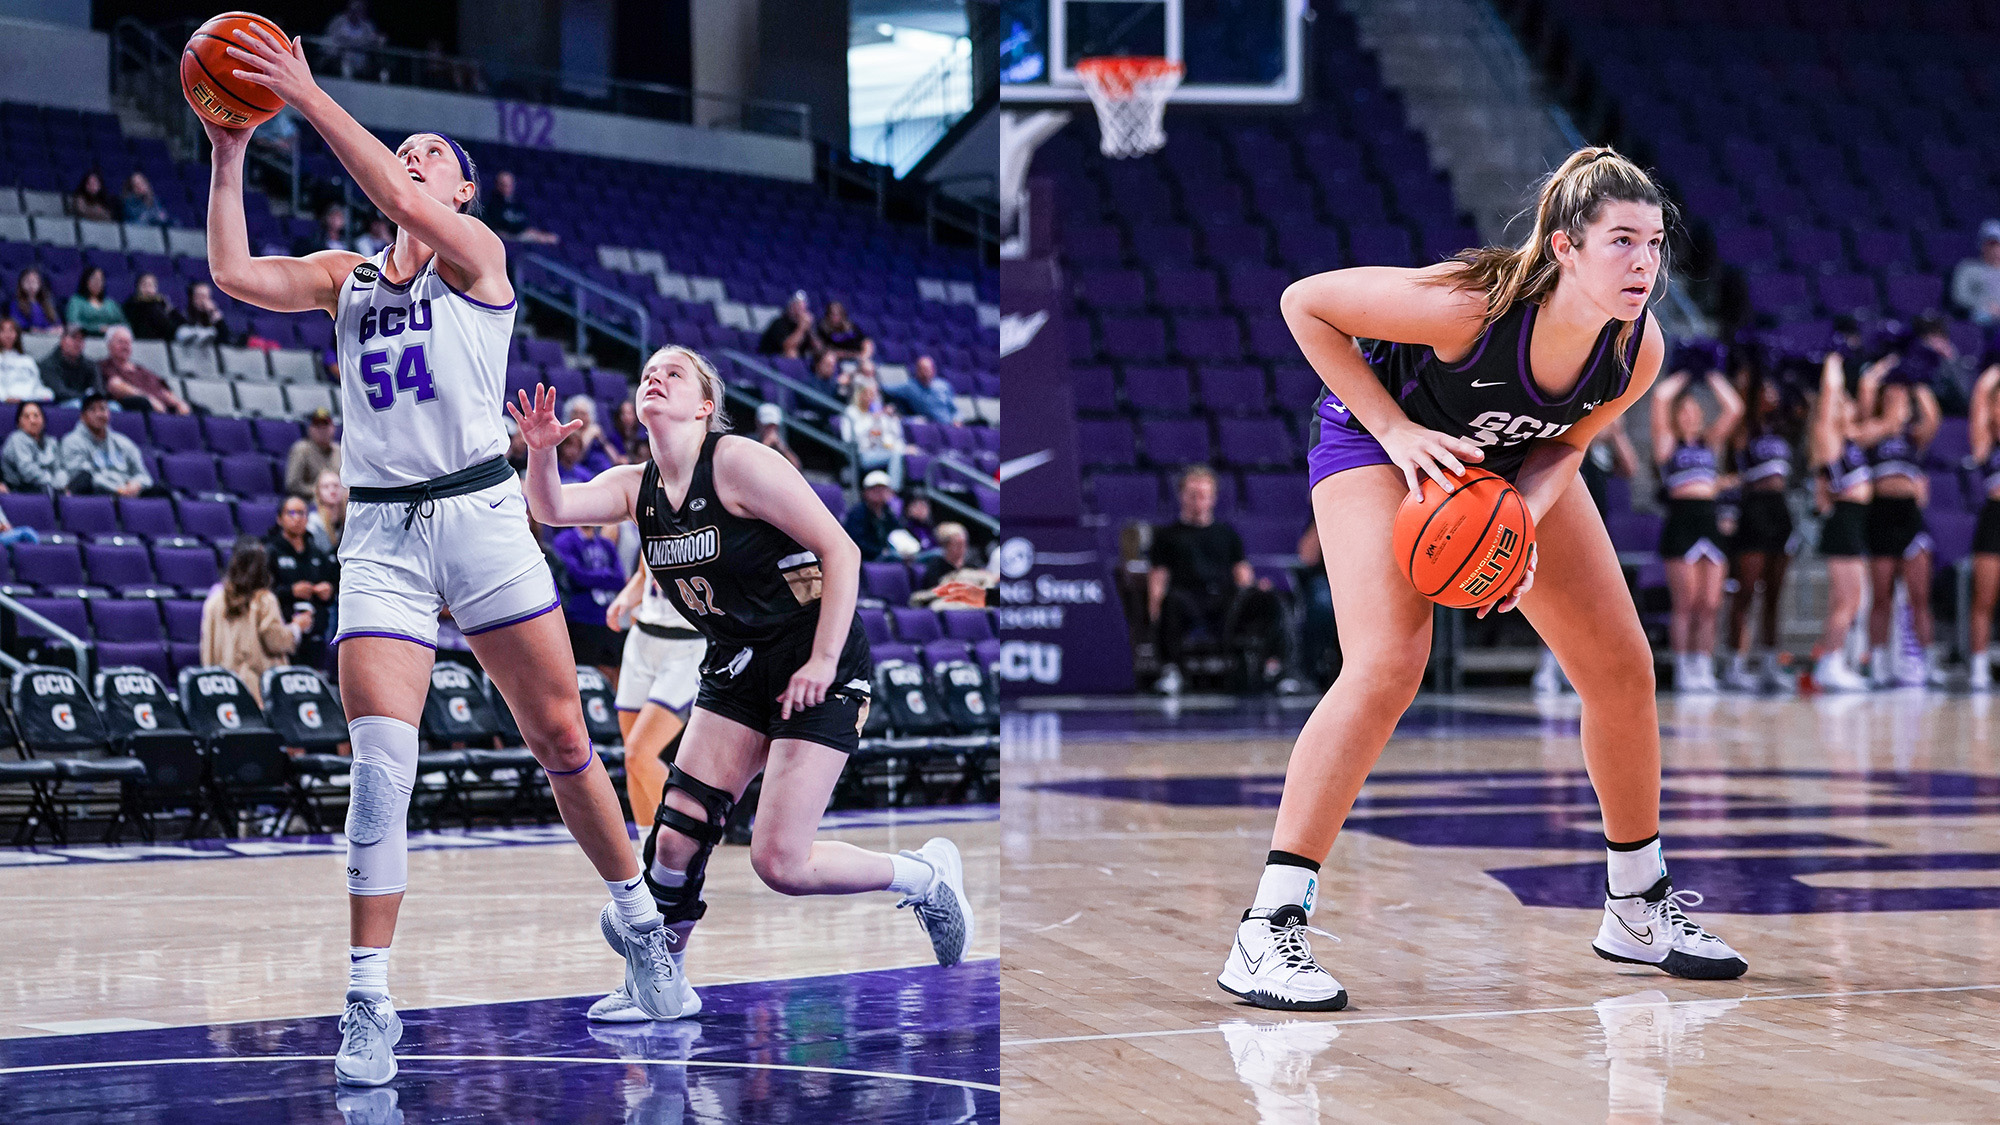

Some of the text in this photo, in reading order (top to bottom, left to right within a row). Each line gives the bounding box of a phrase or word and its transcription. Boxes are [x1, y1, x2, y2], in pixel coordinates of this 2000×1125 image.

[495, 101, 555, 149] 102
[359, 299, 433, 345] GCU
[359, 342, 439, 413] 54
[1459, 524, 1504, 589] CHAMPIONSHIP
[1463, 526, 1518, 597] ELITE
[674, 576, 726, 616] 42
[1000, 579, 1034, 604] NG
[577, 673, 605, 691] CU
[1000, 640, 1062, 684] CU
[32, 674, 76, 696] GCU
[114, 674, 156, 696] GCU
[197, 674, 239, 696] GCU
[280, 673, 321, 695] GCU
